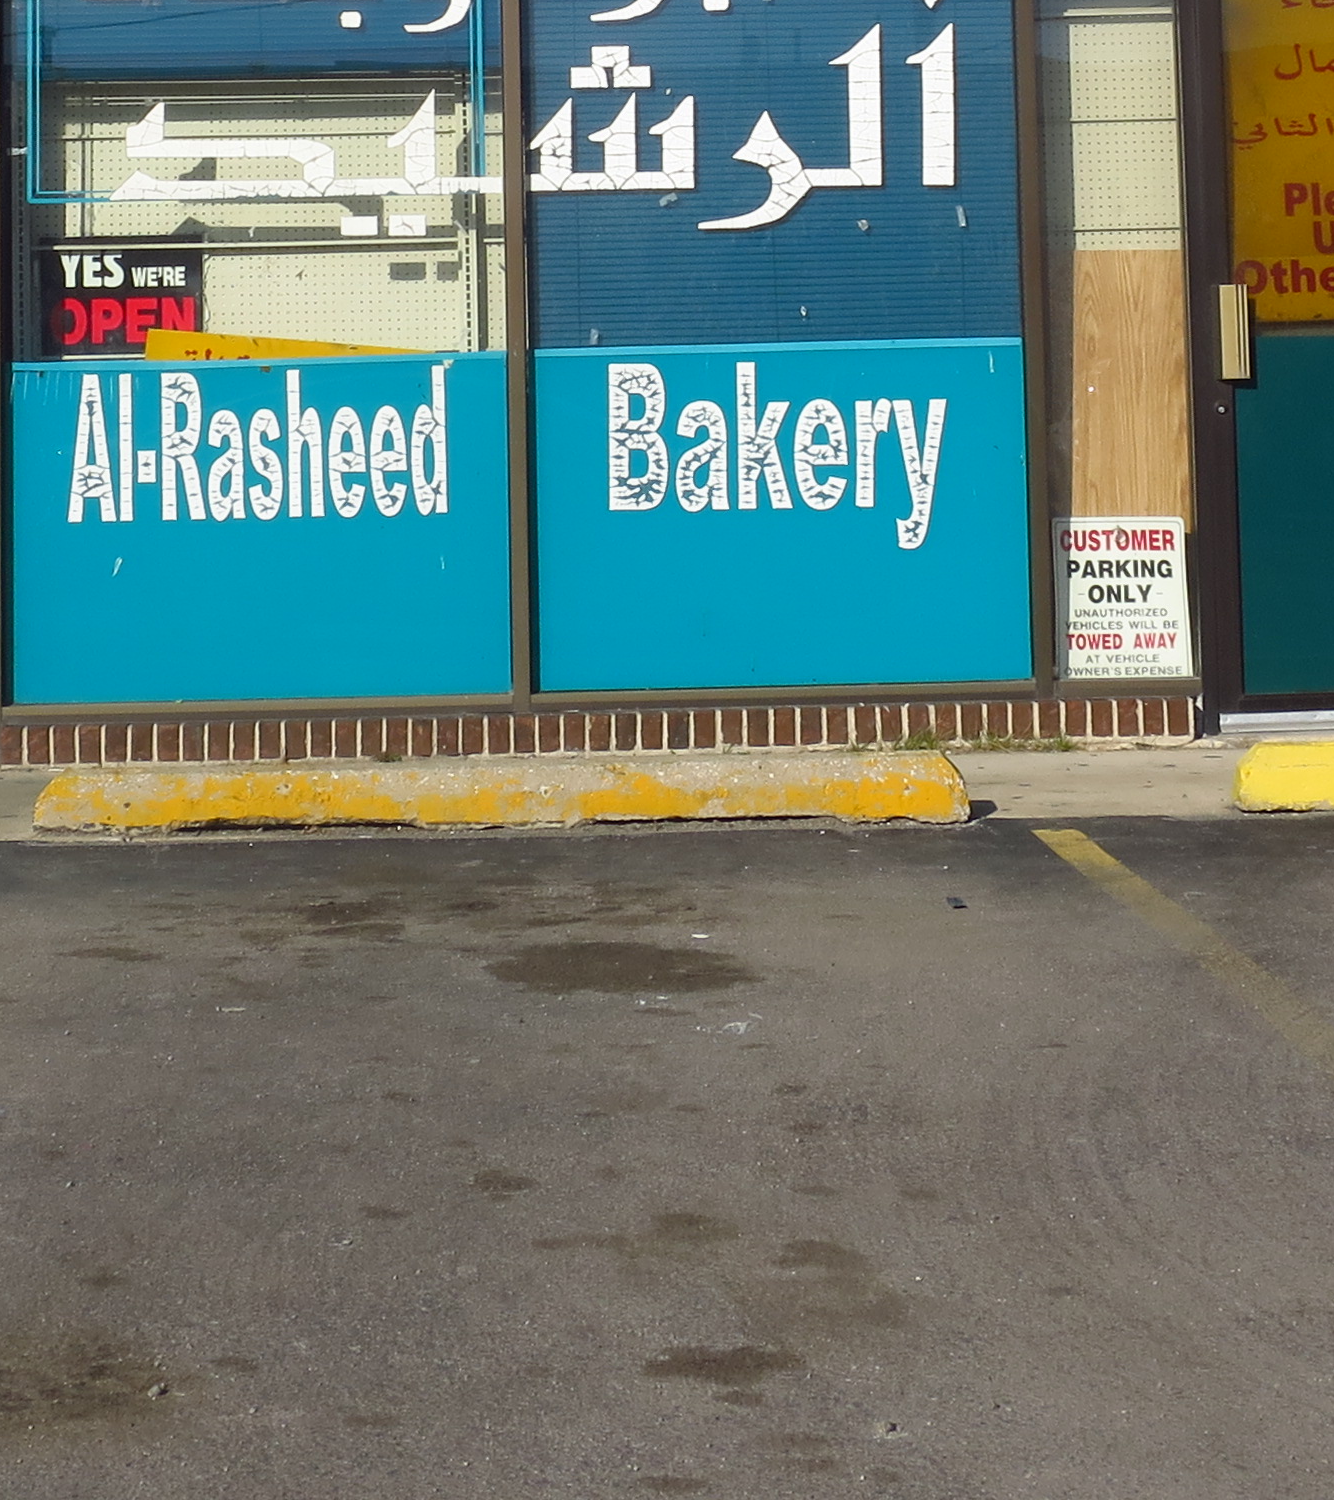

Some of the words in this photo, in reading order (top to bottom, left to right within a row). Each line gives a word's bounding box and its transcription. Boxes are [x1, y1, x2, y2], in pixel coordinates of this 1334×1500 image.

[60, 254, 125, 288] YES
[131, 266, 186, 288] WE'RE
[51, 296, 196, 345] OPEN
[67, 364, 449, 523] Al-Rasheed
[607, 361, 947, 549] Bakery
[1060, 529, 1175, 551] CUSTOMER
[1067, 559, 1173, 579] PARKING
[1088, 584, 1152, 603] ONLY
[1074, 607, 1168, 618] UNAUTHORIZED
[1065, 621, 1123, 630] VEHICLES
[1129, 620, 1157, 630] WILL
[1163, 620, 1179, 629] BE
[1066, 633, 1123, 650] TOWED
[1133, 632, 1177, 649] AWAY
[1085, 654, 1102, 664] AT
[1106, 653, 1160, 663] VEHICLE
[1064, 667, 1121, 676] OWNER'S
[1125, 666, 1183, 676] EXPENSE
